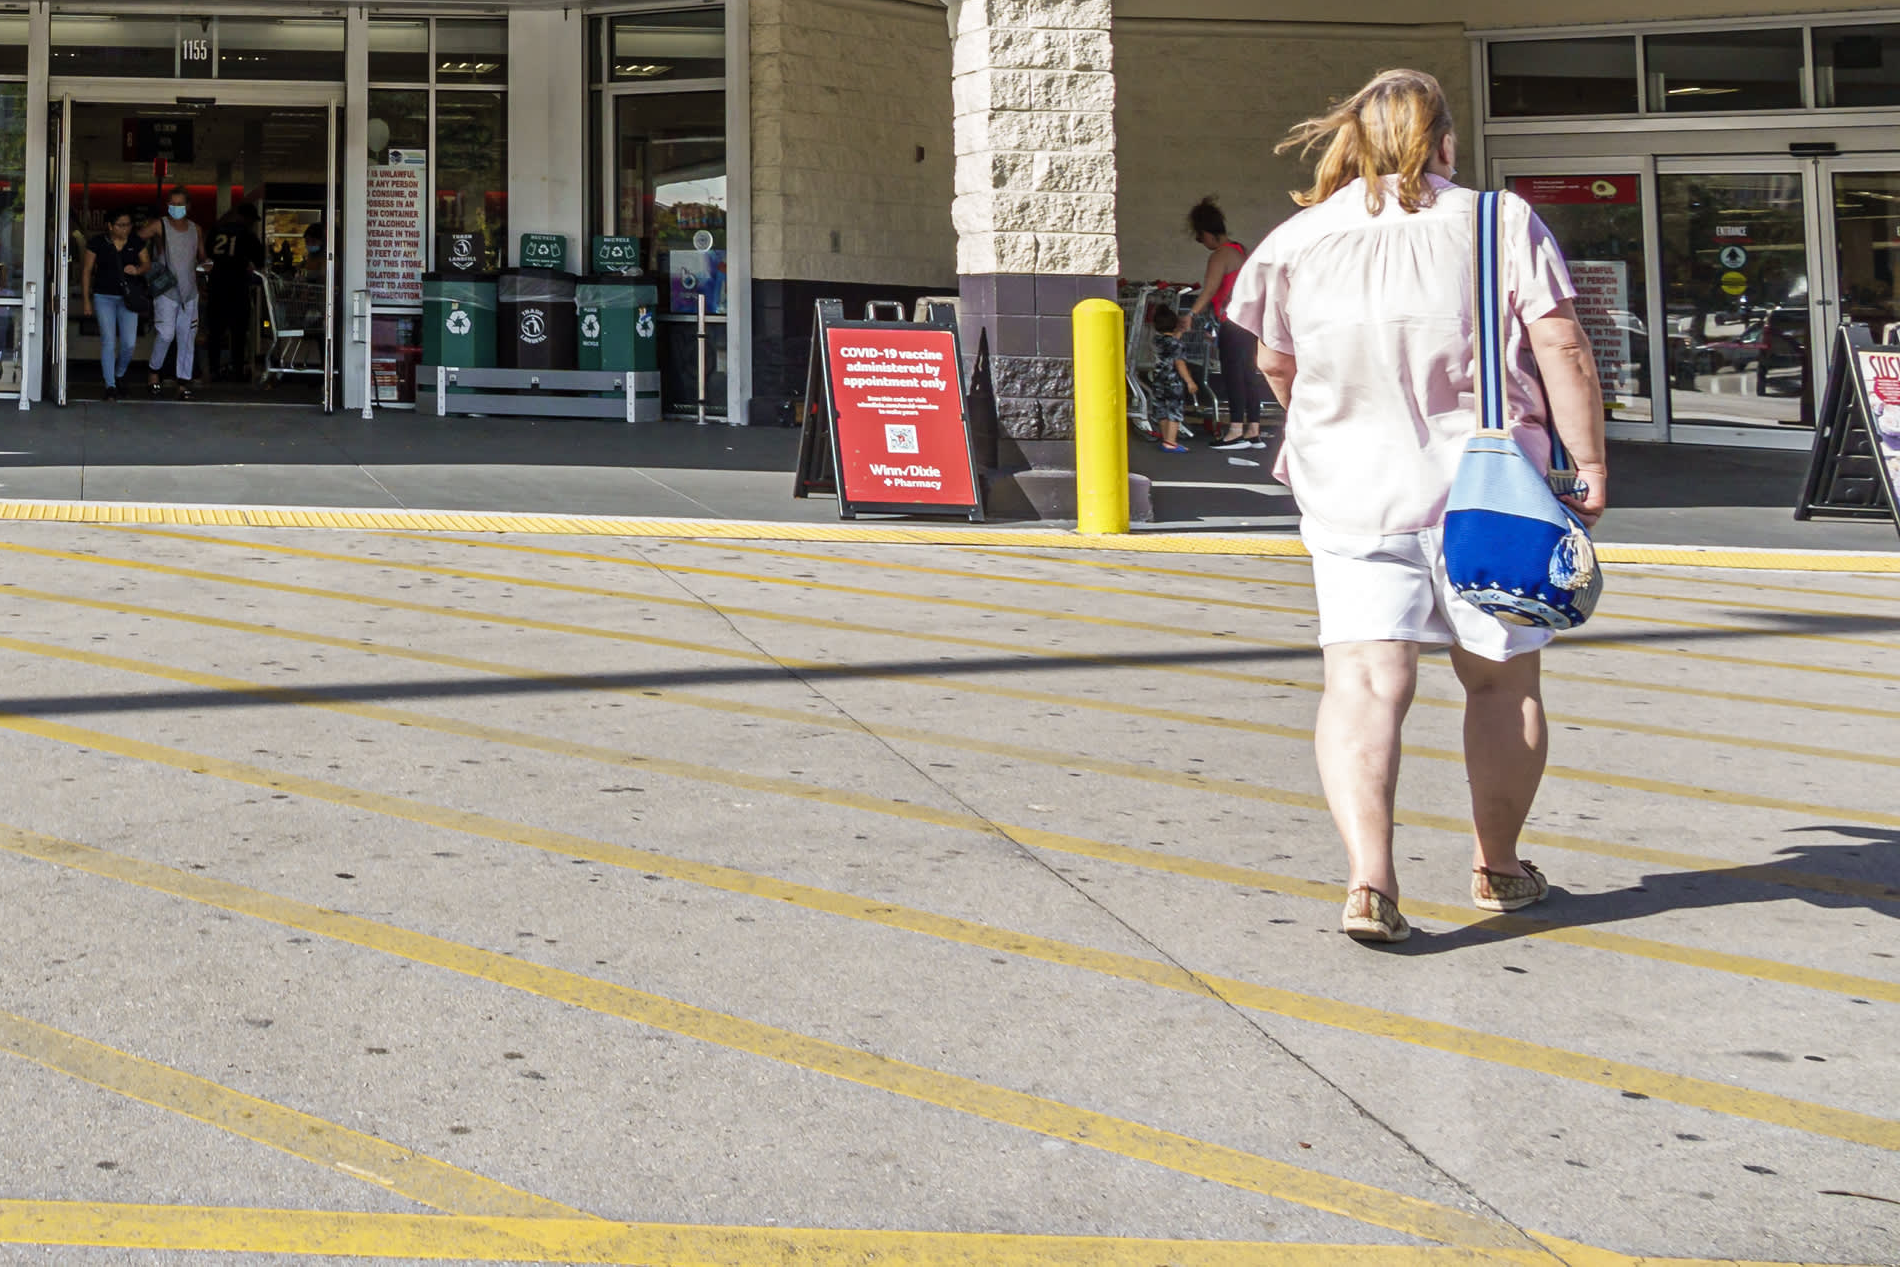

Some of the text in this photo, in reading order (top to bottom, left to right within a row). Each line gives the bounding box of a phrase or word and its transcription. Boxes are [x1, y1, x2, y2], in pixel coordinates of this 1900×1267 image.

[183, 39, 207, 60] 1155
[380, 170, 416, 178] UNLAWFUL
[376, 180, 390, 188] ANY
[391, 180, 419, 188] PERSON
[408, 190, 419, 198] OR
[396, 200, 404, 208] IN
[405, 200, 415, 208] AN
[380, 210, 419, 218] CONTAINER
[378, 220, 416, 228] ALCOHOLIC
[395, 230, 403, 238] IN
[404, 230, 420, 239] THIS
[1715, 226, 1748, 237] ENTRANCE
[213, 234, 237, 256] 21
[394, 240, 419, 248] WITHIN
[403, 250, 417, 258] ANY
[383, 260, 399, 268] THIS
[402, 272, 415, 280] ARE
[398, 282, 424, 291] ARREST
[840, 346, 944, 360] COVID-19 vaccine
[846, 361, 941, 377] administered by
[1868, 355, 1900, 380] SUS
[843, 375, 947, 391] appointment only
[869, 463, 941, 477] Winn Dixie
[894, 478, 942, 491] Pharmacy
